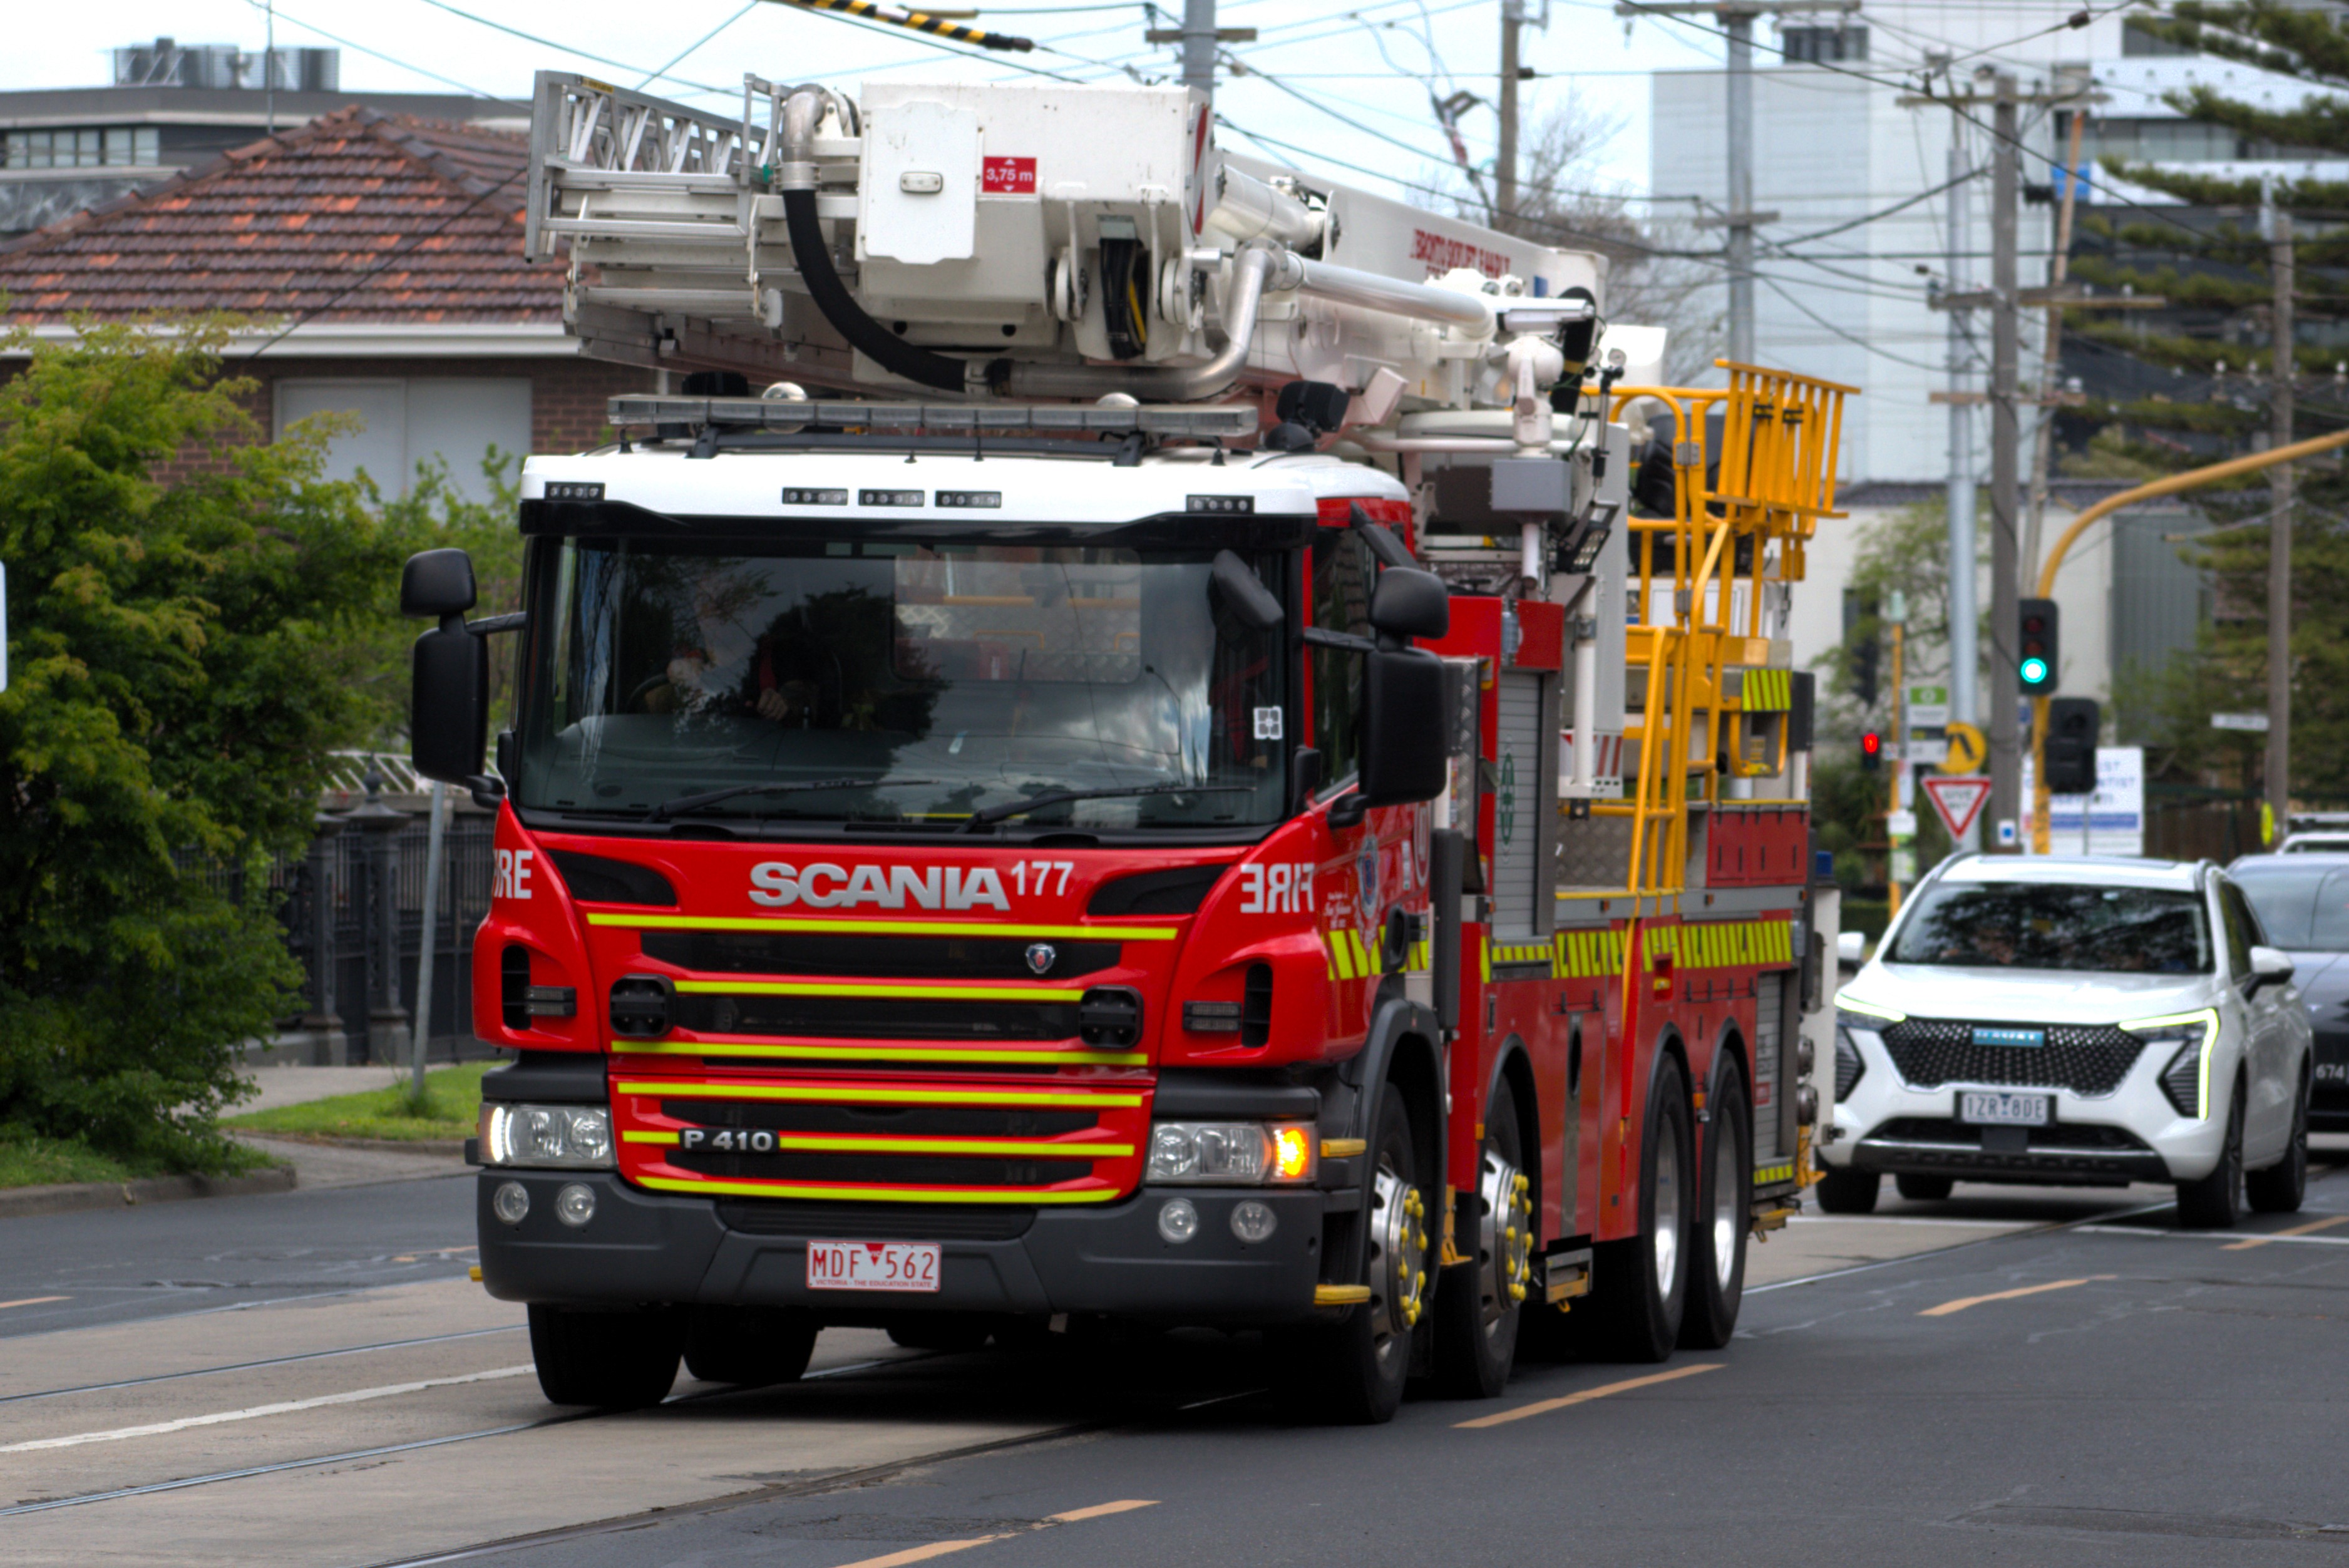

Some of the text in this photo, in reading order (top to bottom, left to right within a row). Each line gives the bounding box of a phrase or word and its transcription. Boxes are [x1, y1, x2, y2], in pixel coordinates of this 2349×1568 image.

[986, 167, 1033, 183] 3,75 m
[493, 848, 533, 899] IRE
[748, 861, 1011, 911] SCANIA
[1010, 860, 1074, 896] 177
[684, 1130, 773, 1151] P 410
[813, 1249, 935, 1280] MDF 562
